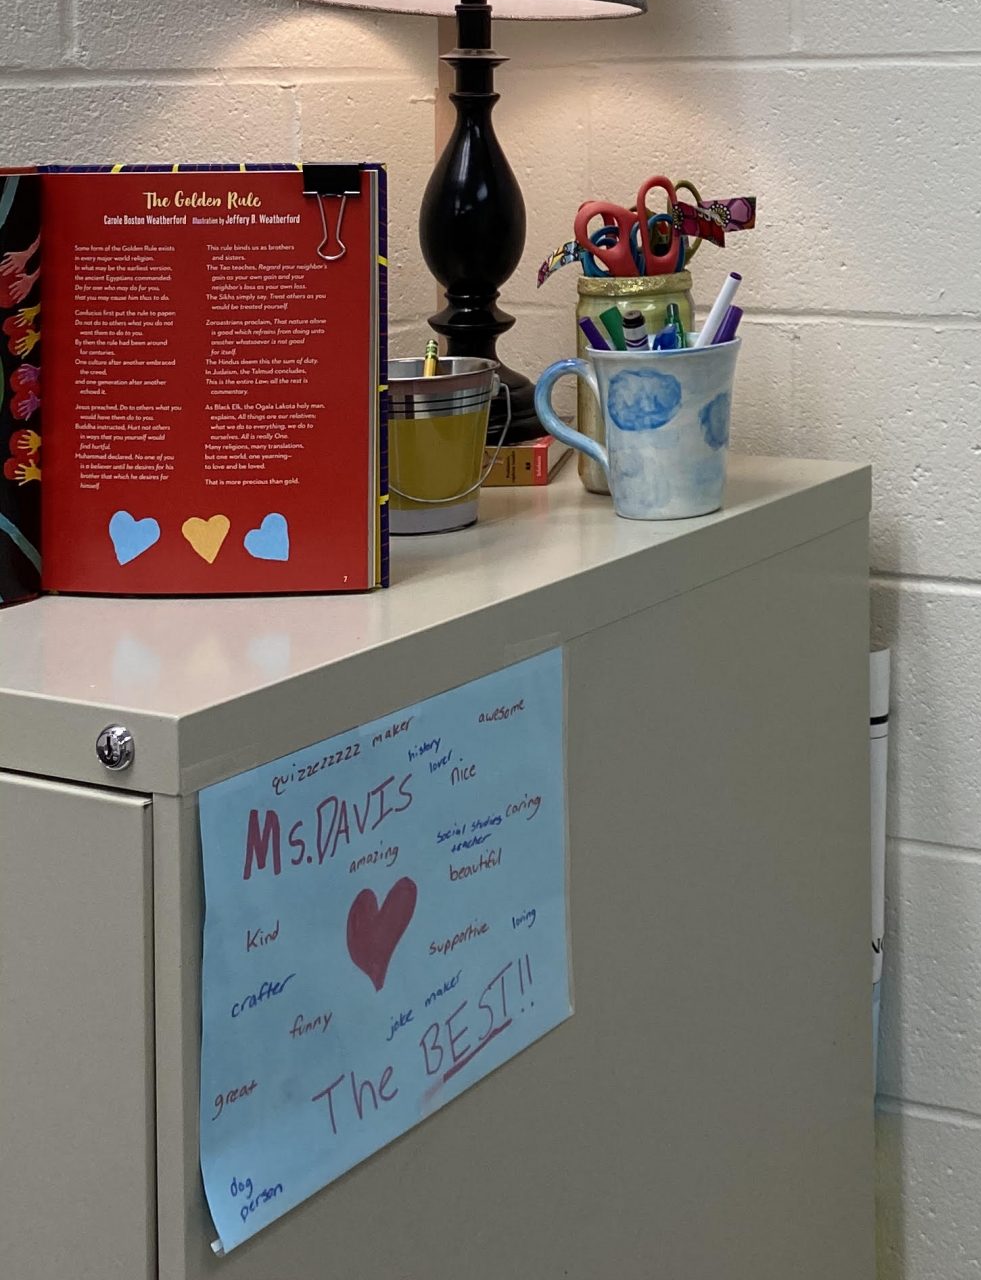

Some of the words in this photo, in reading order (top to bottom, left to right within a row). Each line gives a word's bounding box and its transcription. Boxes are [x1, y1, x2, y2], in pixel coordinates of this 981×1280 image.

[143, 191, 171, 210] The
[174, 190, 222, 208] Golden
[227, 191, 262, 210] Rule
[104, 215, 123, 225] Carole
[124, 215, 145, 225] Boston
[146, 215, 187, 225] Weatherford
[219, 216, 225, 225] by
[225, 214, 250, 226] Jeffery
[251, 214, 258, 224] B.
[259, 214, 301, 224] Weatherford
[268, 243, 295, 251] brothers
[226, 462, 238, 470] and
[242, 478, 268, 487] precious
[478, 699, 525, 723] awesome
[372, 716, 415, 747] maker
[408, 737, 441, 762] history
[429, 749, 452, 773] lover
[451, 833, 492, 853] teacher
[349, 840, 399, 873] amazing
[450, 847, 502, 881] beautiful
[512, 908, 536, 929] loving
[231, 973, 297, 1018] crafter
[386, 1009, 415, 1042] joke
[424, 969, 463, 1007] maker
[289, 1012, 333, 1039] funny
[212, 1079, 258, 1121] great
[311, 1066, 399, 1135] The
[230, 1177, 253, 1199] dog
[240, 1182, 284, 1223] person
